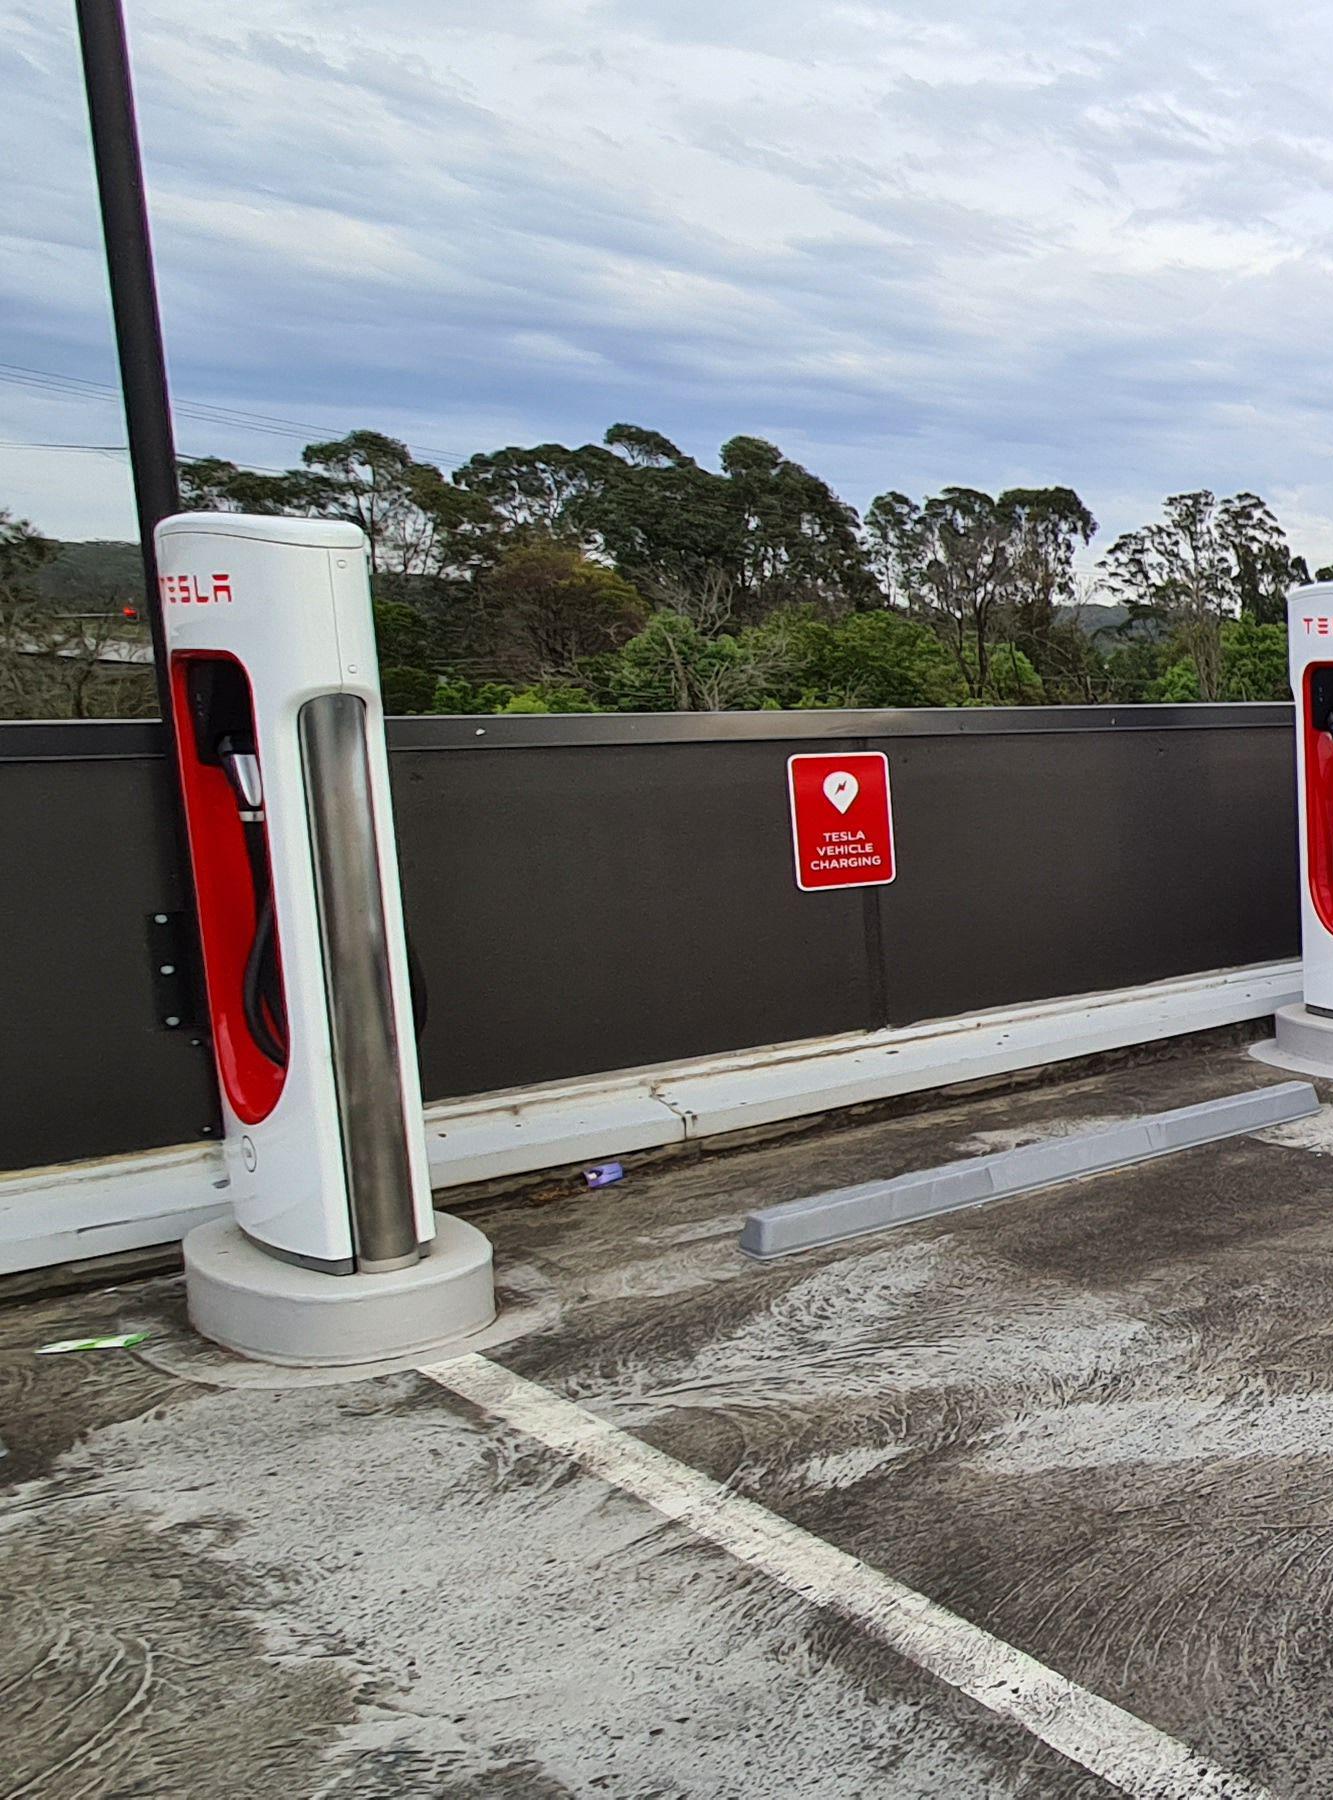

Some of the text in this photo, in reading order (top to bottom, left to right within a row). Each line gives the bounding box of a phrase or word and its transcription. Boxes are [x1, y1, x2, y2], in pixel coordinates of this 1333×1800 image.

[160, 574, 232, 603] ESLA
[823, 830, 866, 842] TESLA
[816, 842, 874, 856] VEHICLE
[810, 855, 881, 871] CHARGING
